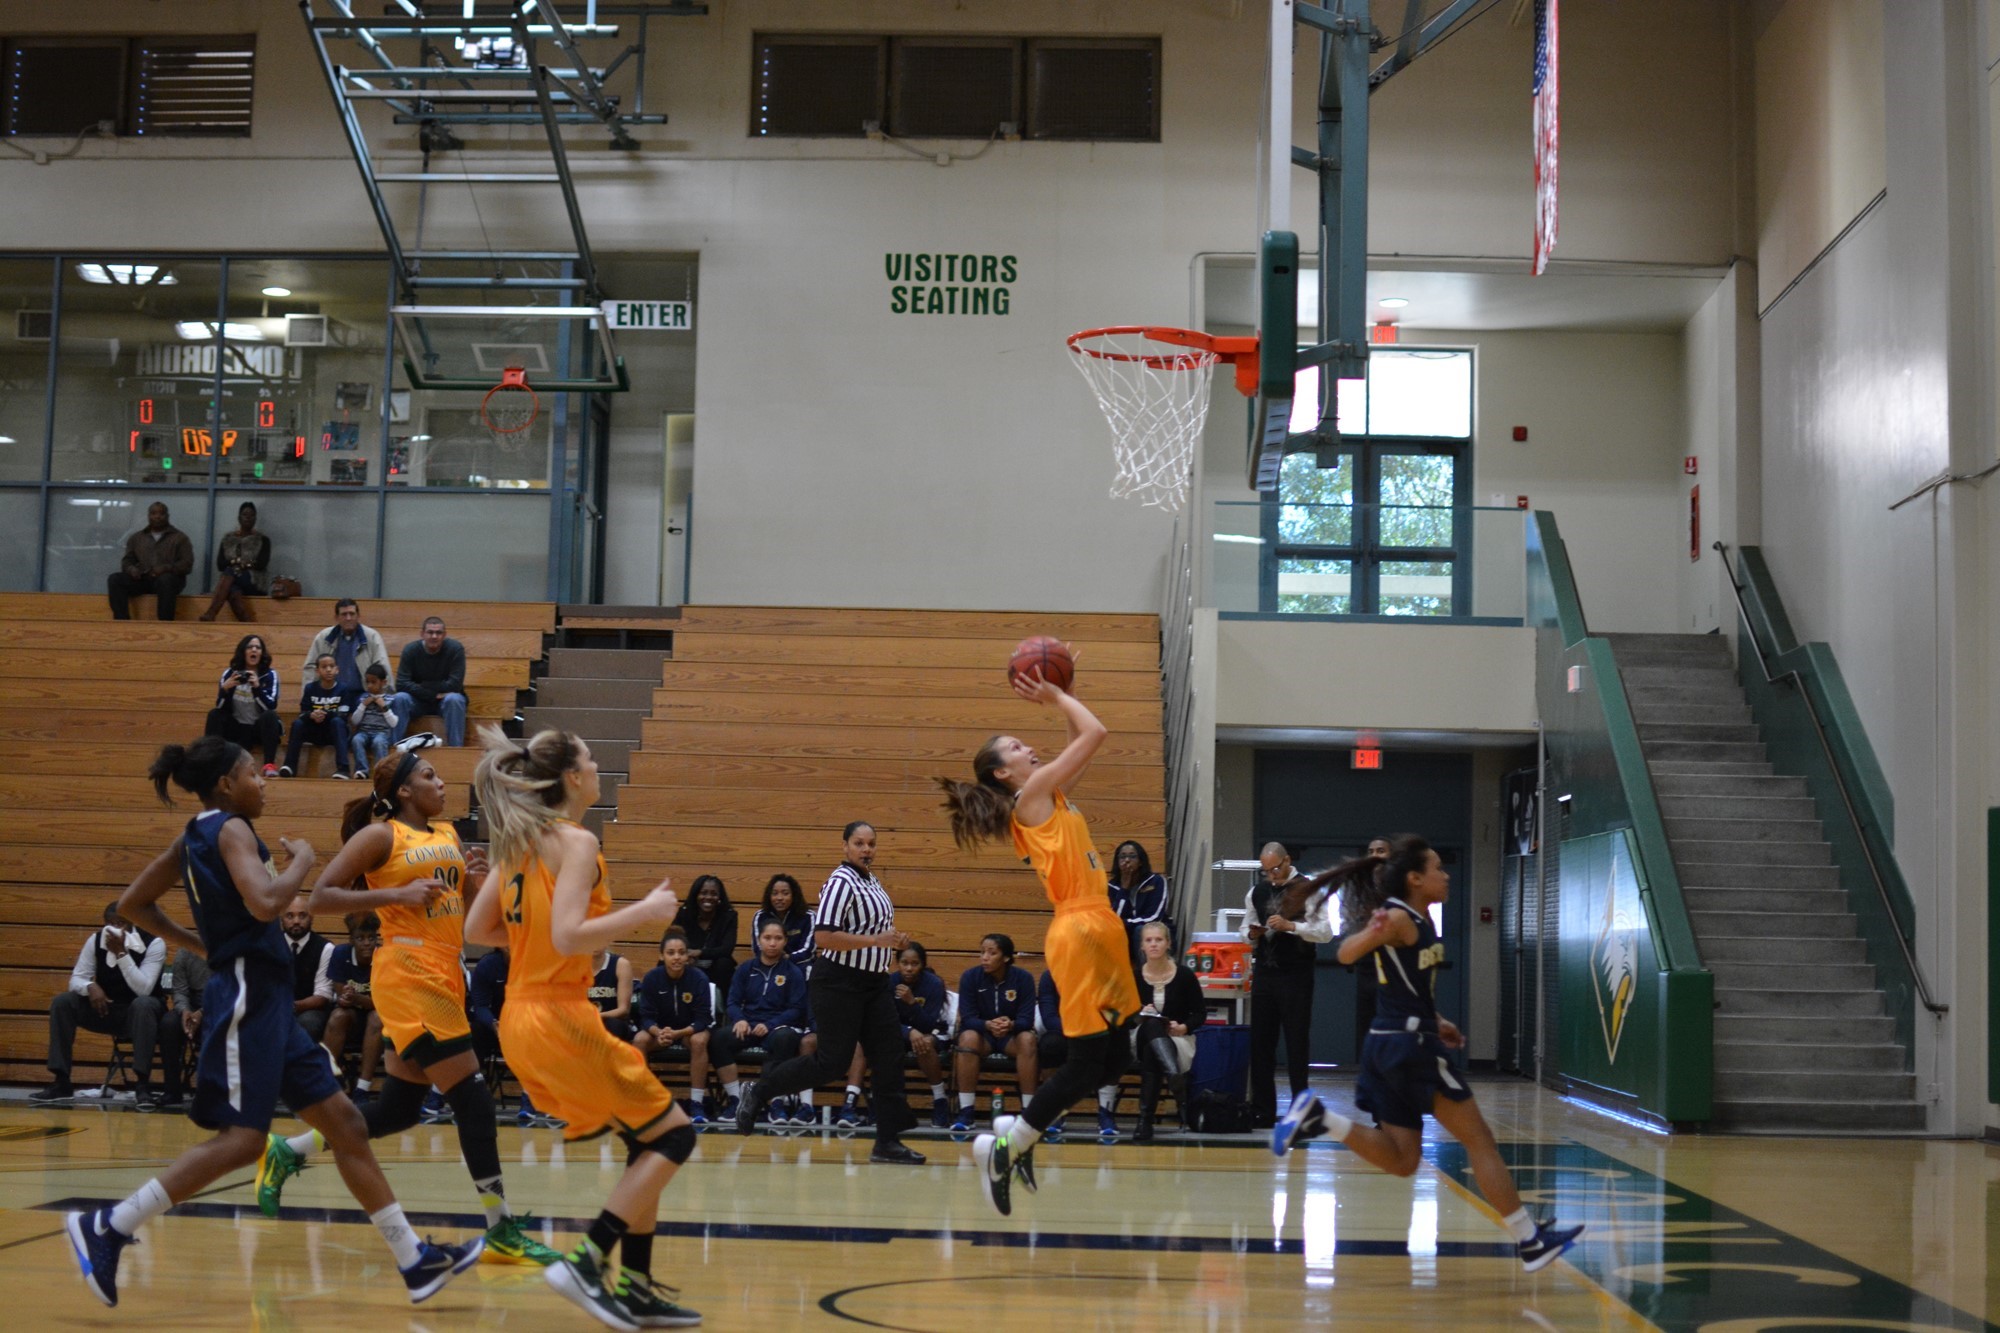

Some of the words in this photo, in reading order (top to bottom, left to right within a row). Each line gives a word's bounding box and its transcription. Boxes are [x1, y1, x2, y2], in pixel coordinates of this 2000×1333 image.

[885, 253, 1018, 283] VISITORS
[891, 285, 1010, 315] SEATING
[616, 303, 686, 327] ENTER
[1186, 958, 1197, 968] G
[1203, 960, 1213, 969] G
[992, 1099, 1003, 1109] G
